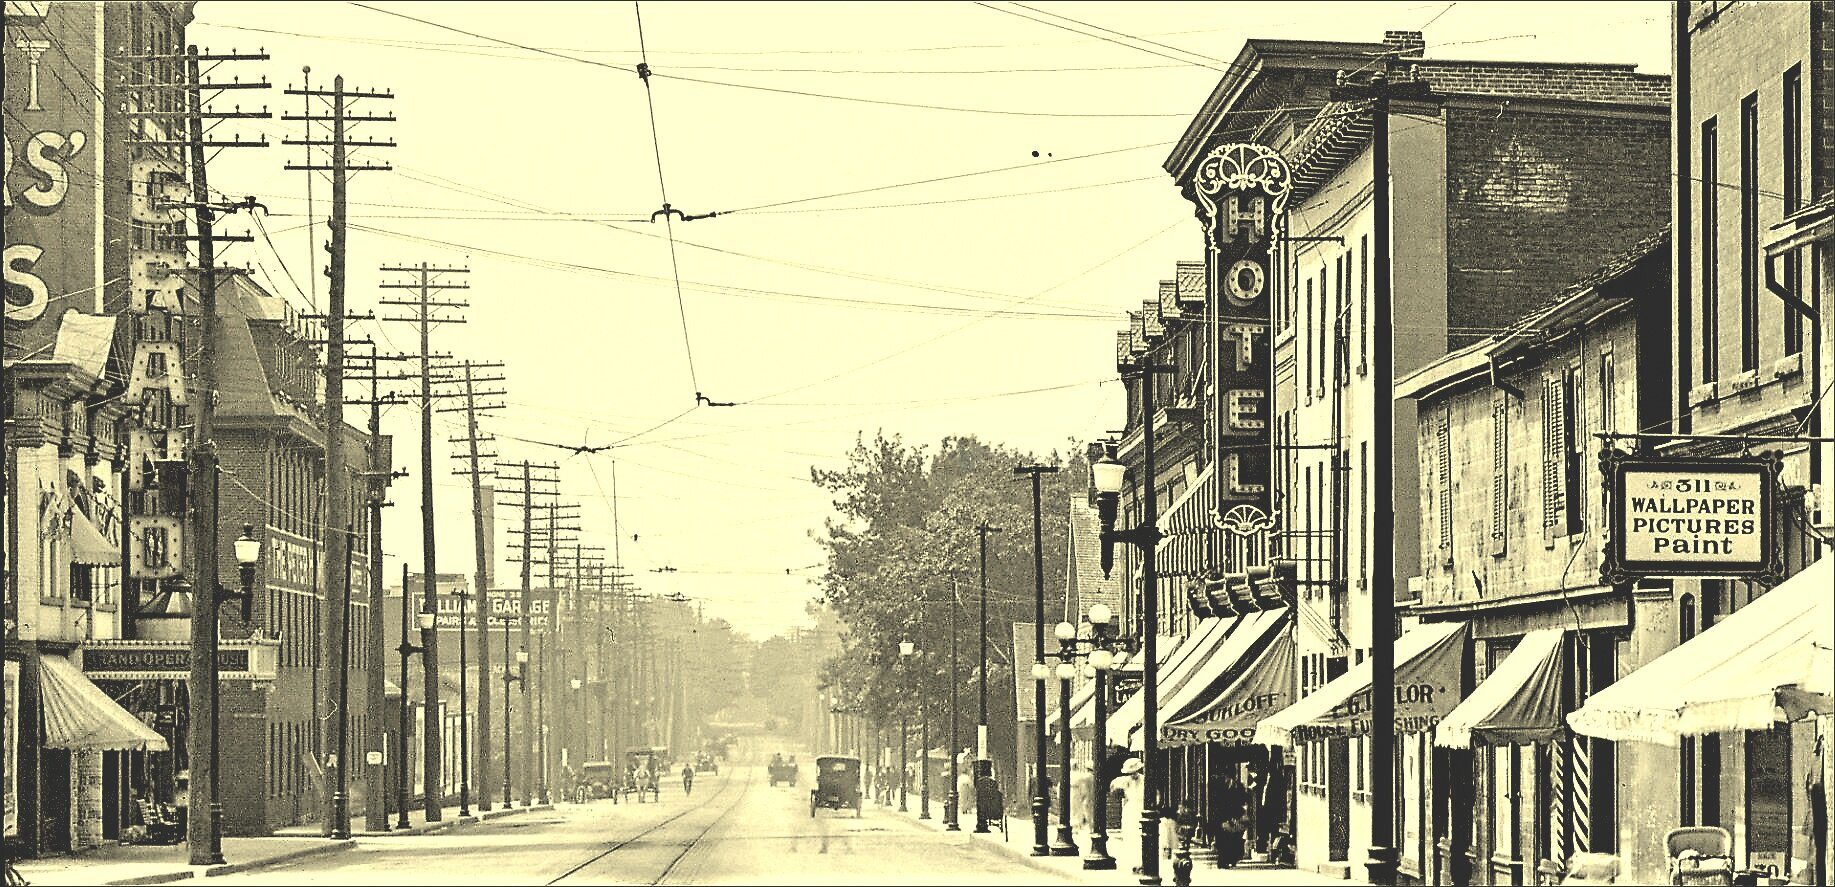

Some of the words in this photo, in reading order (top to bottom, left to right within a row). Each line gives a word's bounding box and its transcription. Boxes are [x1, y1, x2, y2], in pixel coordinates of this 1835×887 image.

[1222, 196, 1265, 501] HOTEL
[1675, 479, 1711, 493] 311
[1631, 497, 1755, 515] WALLPAPER
[1633, 518, 1755, 535] PICTURES
[1654, 534, 1733, 554] Paint
